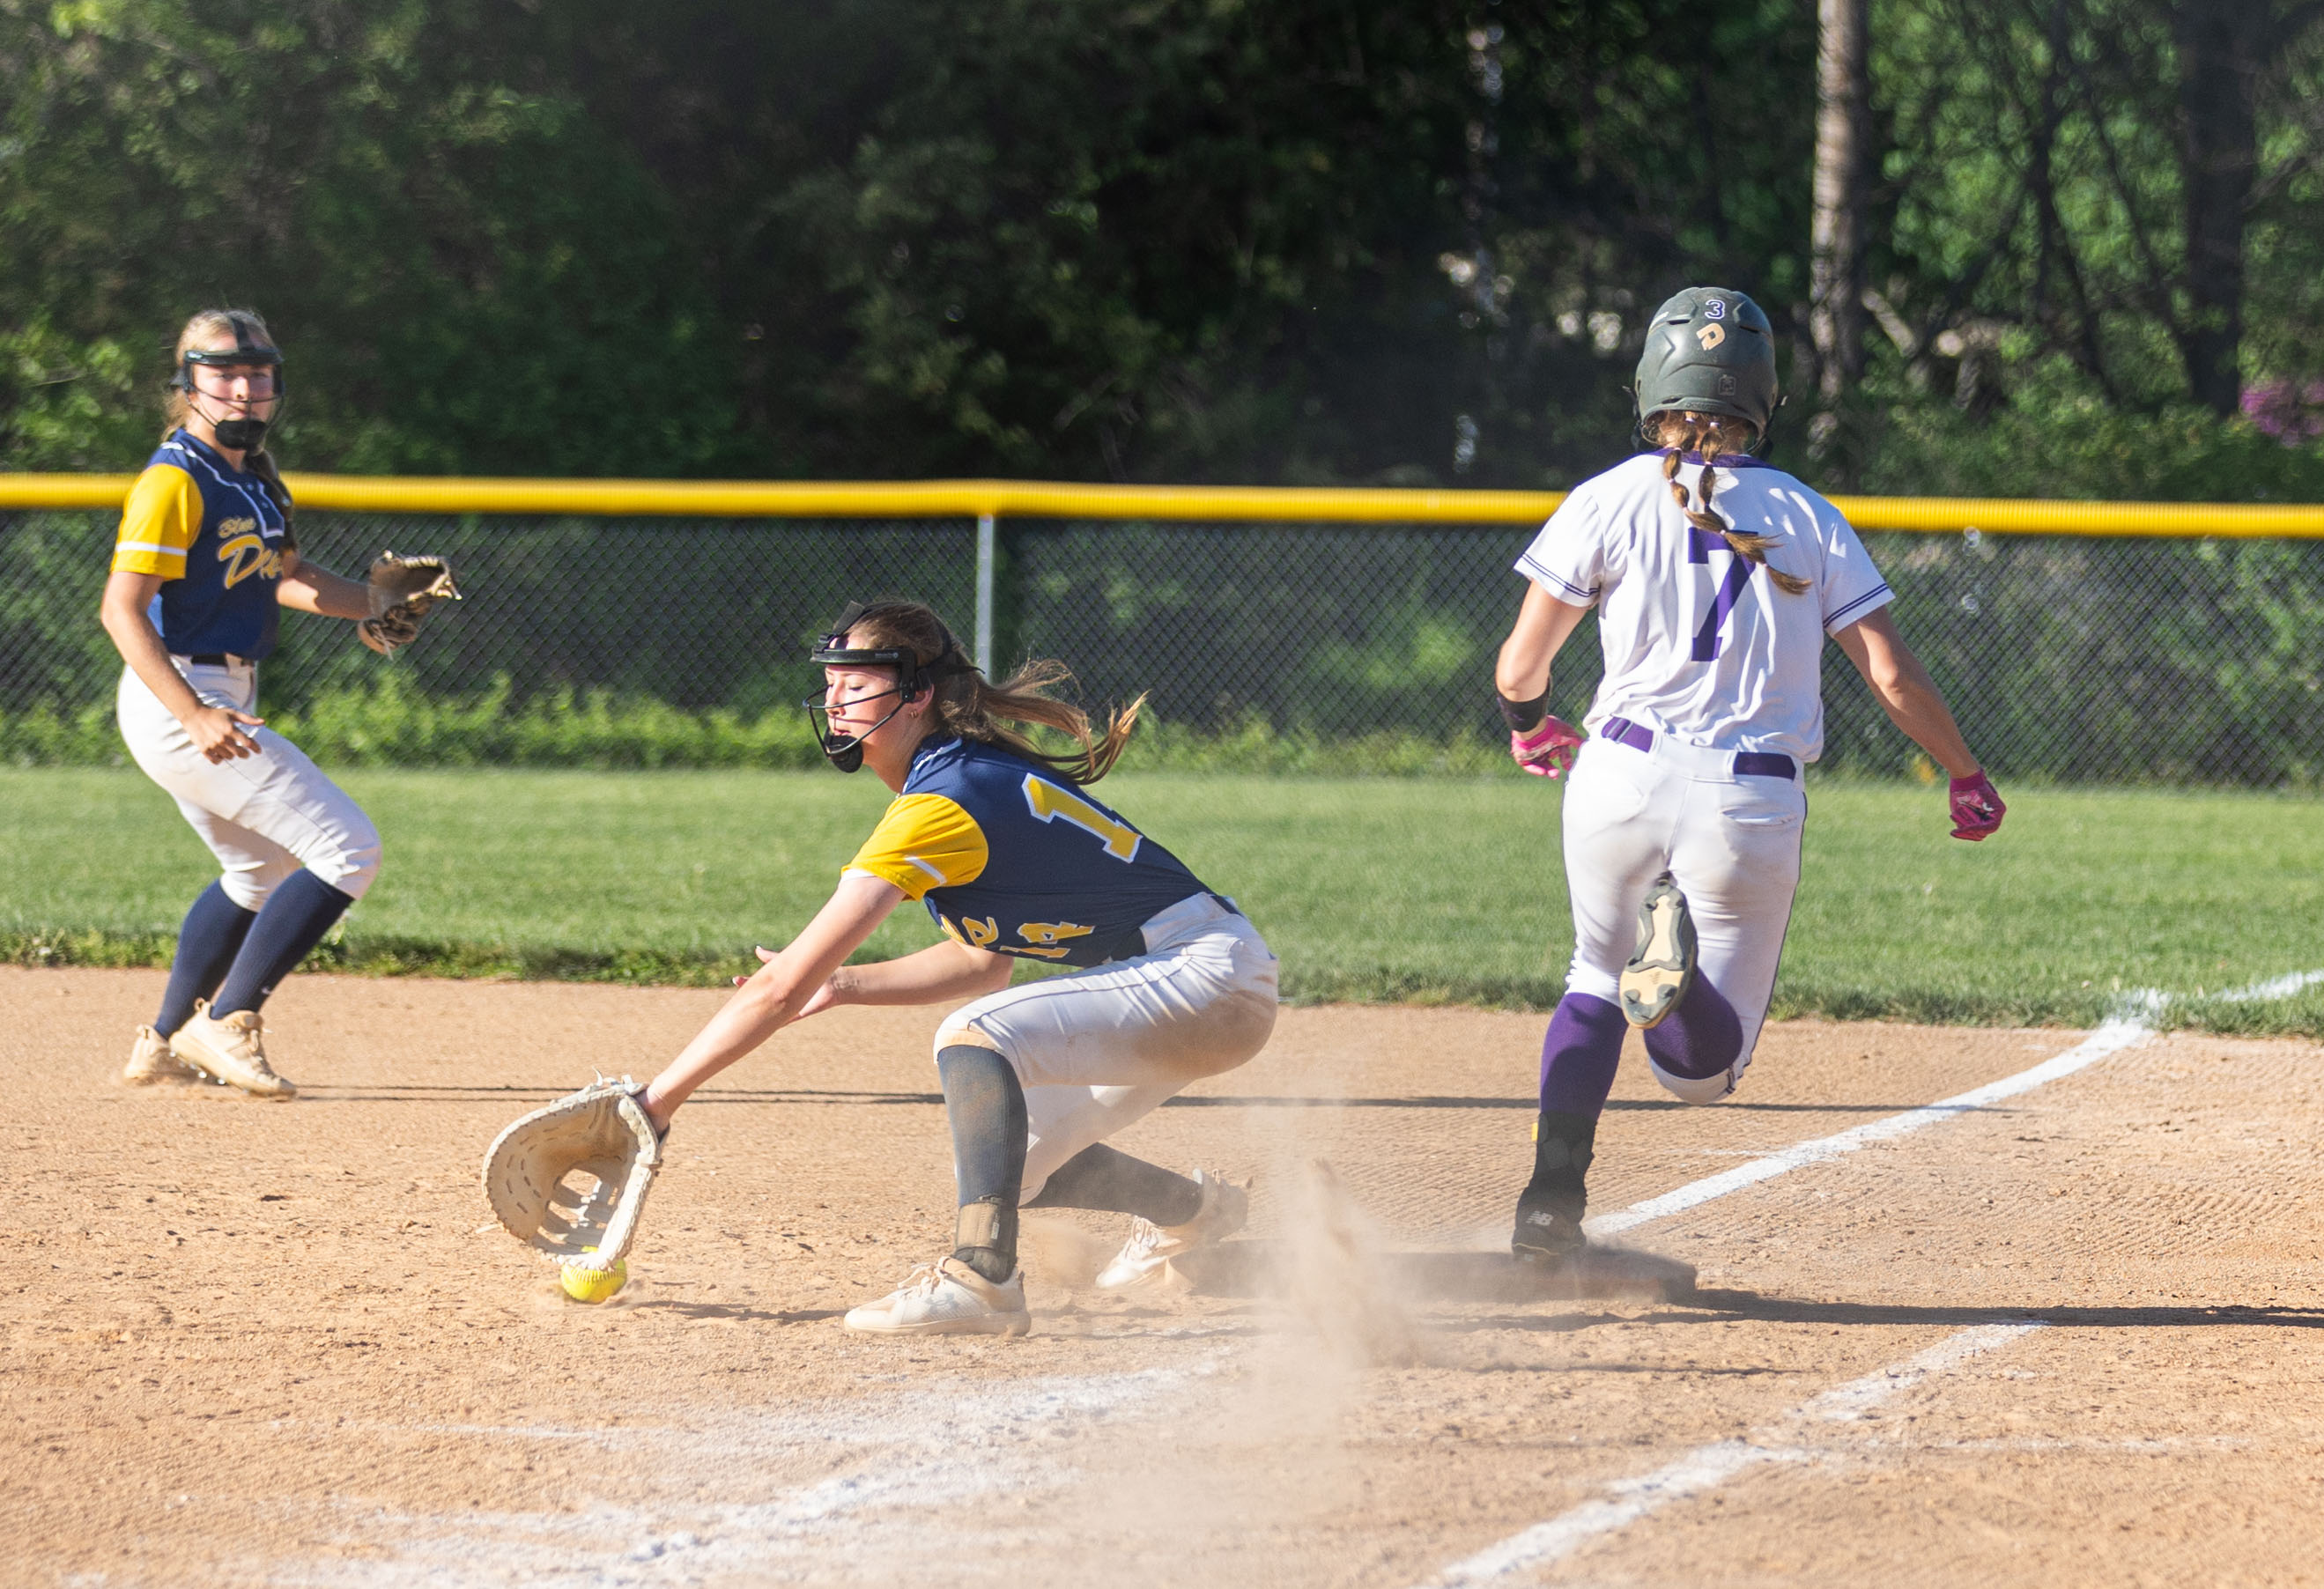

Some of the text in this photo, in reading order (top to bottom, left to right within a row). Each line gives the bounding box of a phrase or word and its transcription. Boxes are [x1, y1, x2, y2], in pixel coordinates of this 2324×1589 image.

[1705, 299, 1726, 320] 3
[1688, 527, 1758, 661] 7
[1022, 772, 1143, 863] 1
